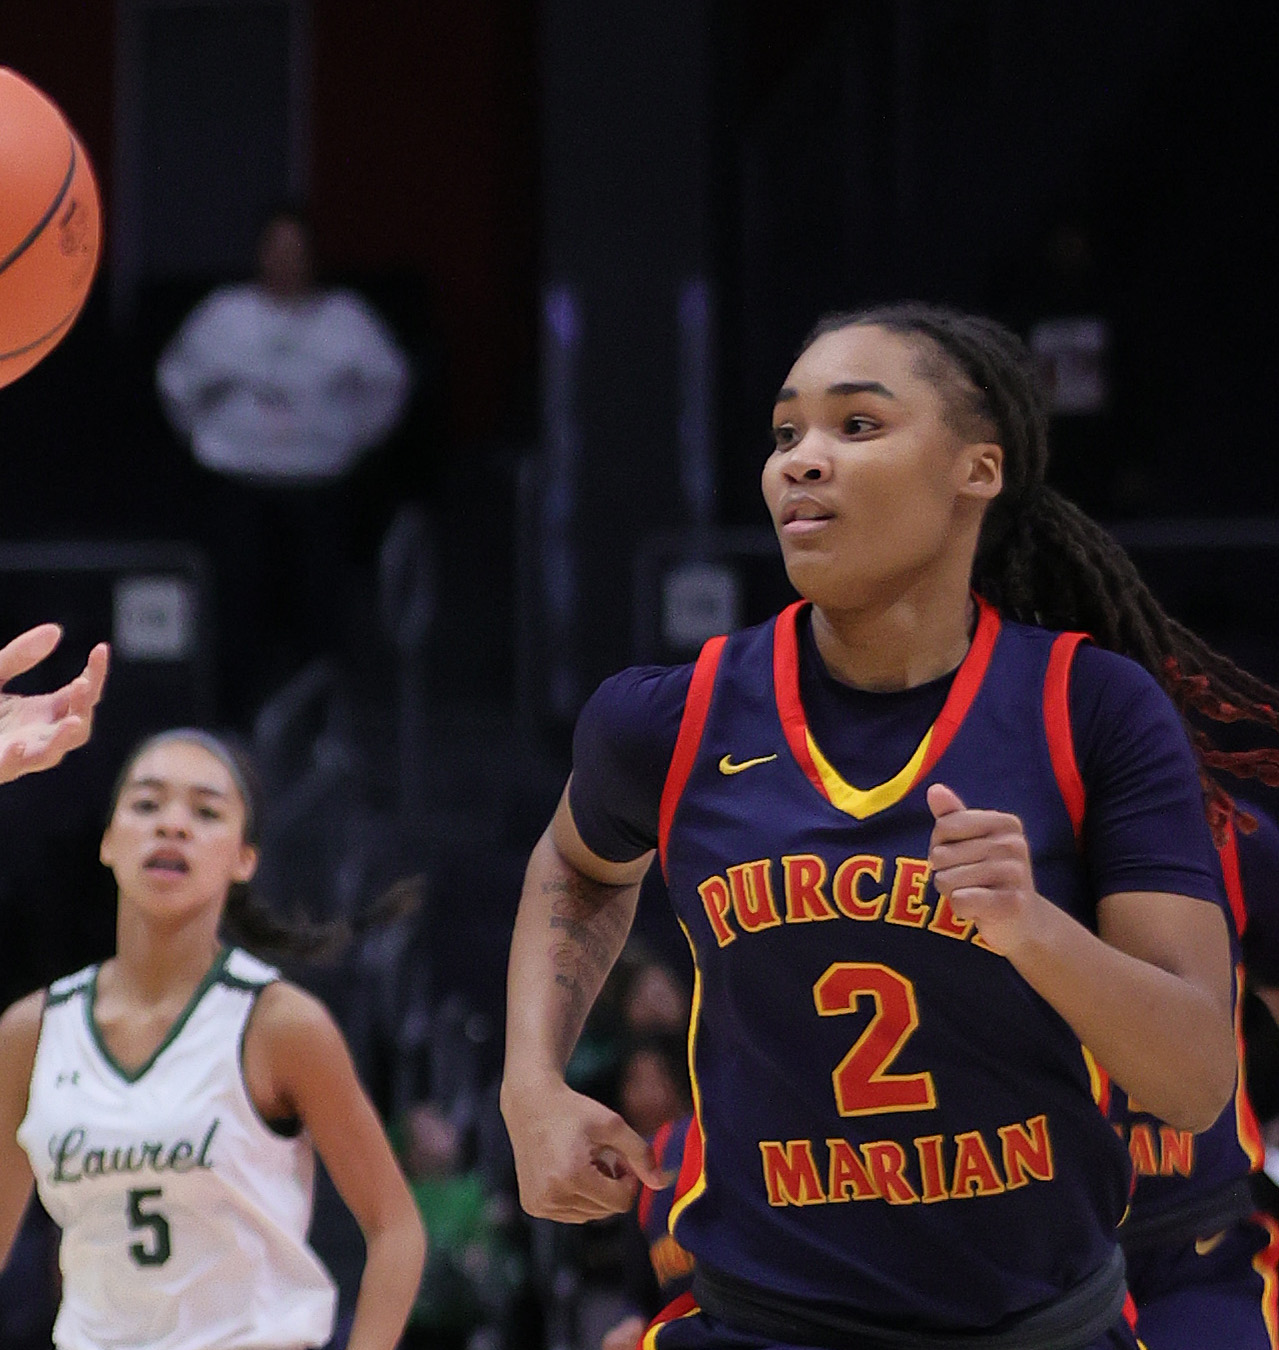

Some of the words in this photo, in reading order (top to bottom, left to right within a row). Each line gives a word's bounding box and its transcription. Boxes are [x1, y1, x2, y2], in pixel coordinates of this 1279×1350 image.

[697, 853, 1007, 957] PURCEL
[812, 961, 937, 1118] 2
[48, 1117, 222, 1183] Laurel
[759, 1114, 1055, 1207] MARIAN
[127, 1187, 171, 1267] 5
